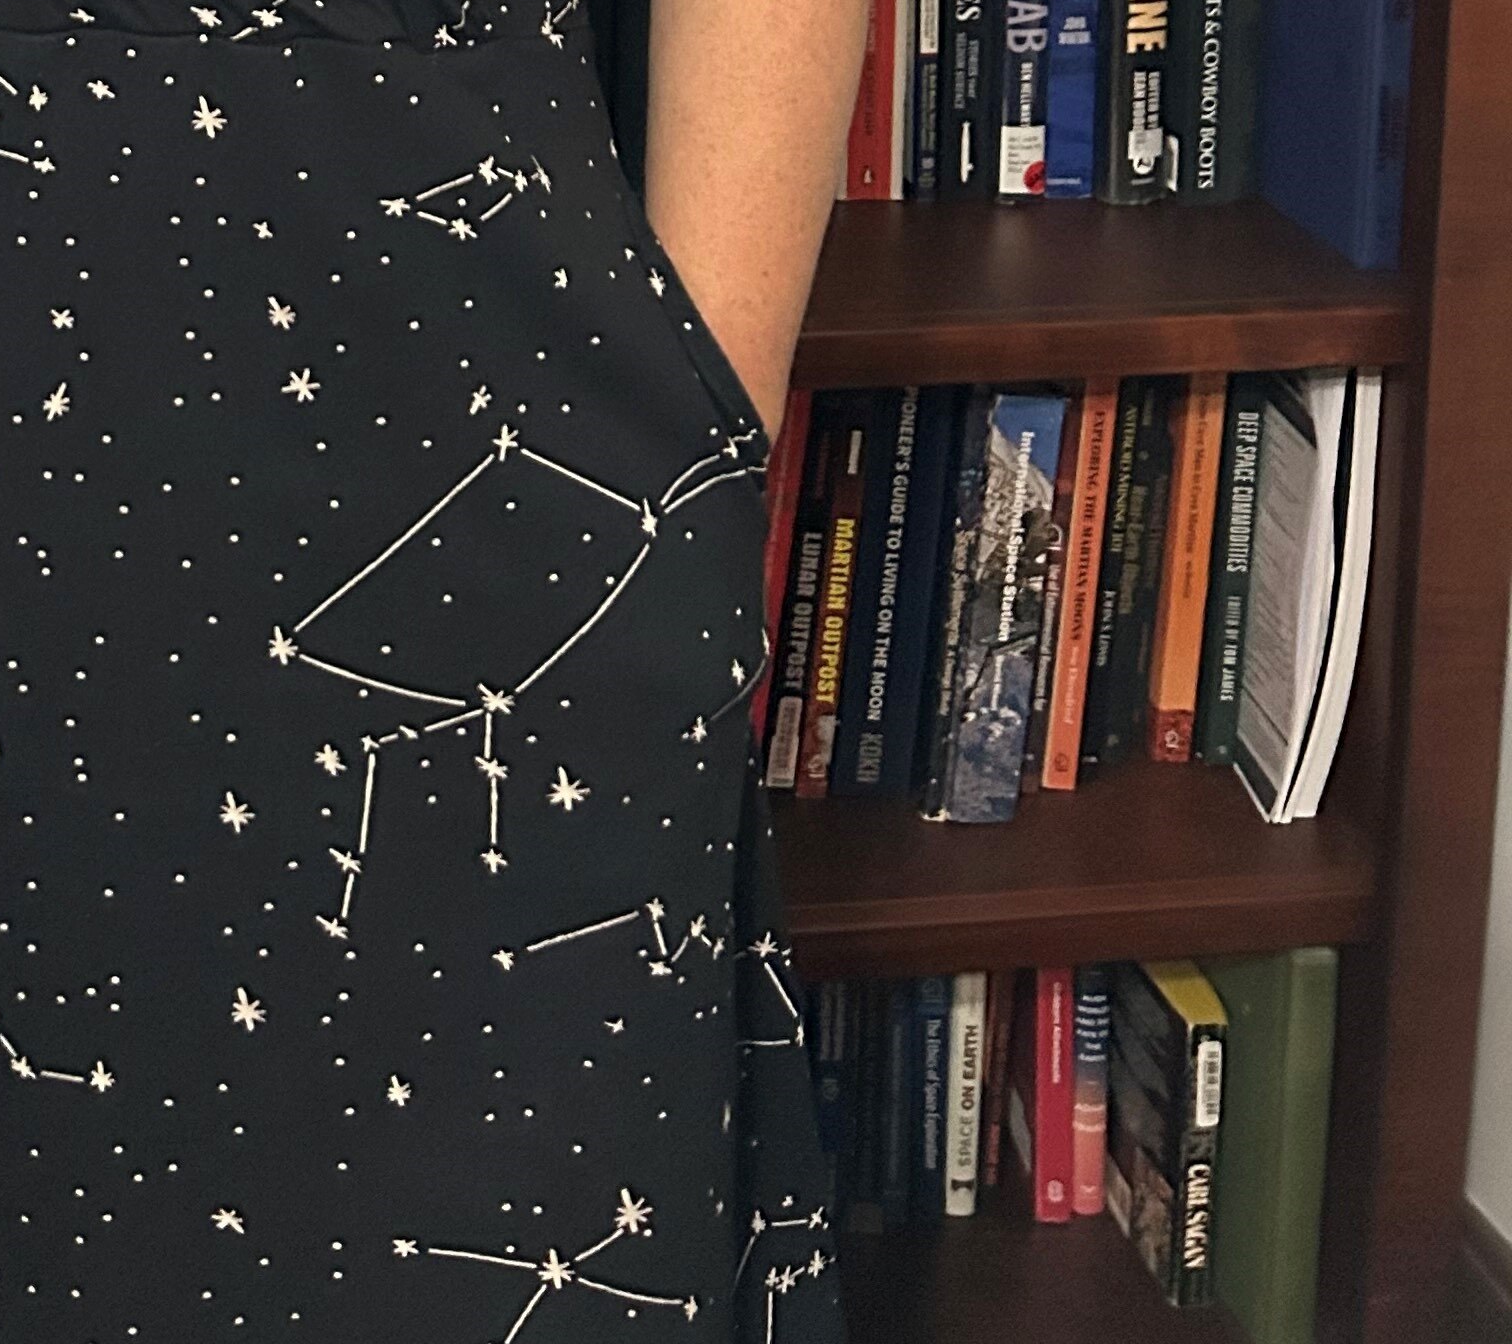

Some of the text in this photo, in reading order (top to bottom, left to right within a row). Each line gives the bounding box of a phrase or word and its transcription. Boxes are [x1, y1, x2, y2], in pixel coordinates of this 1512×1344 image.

[1204, 21, 1221, 34] &
[1200, 38, 1220, 122] COWBOY
[1197, 127, 1216, 188] BOOTS
[815, 517, 854, 703] MARTIAN OUTPOST
[957, 1024, 979, 1165] SPACE ON EARTH
